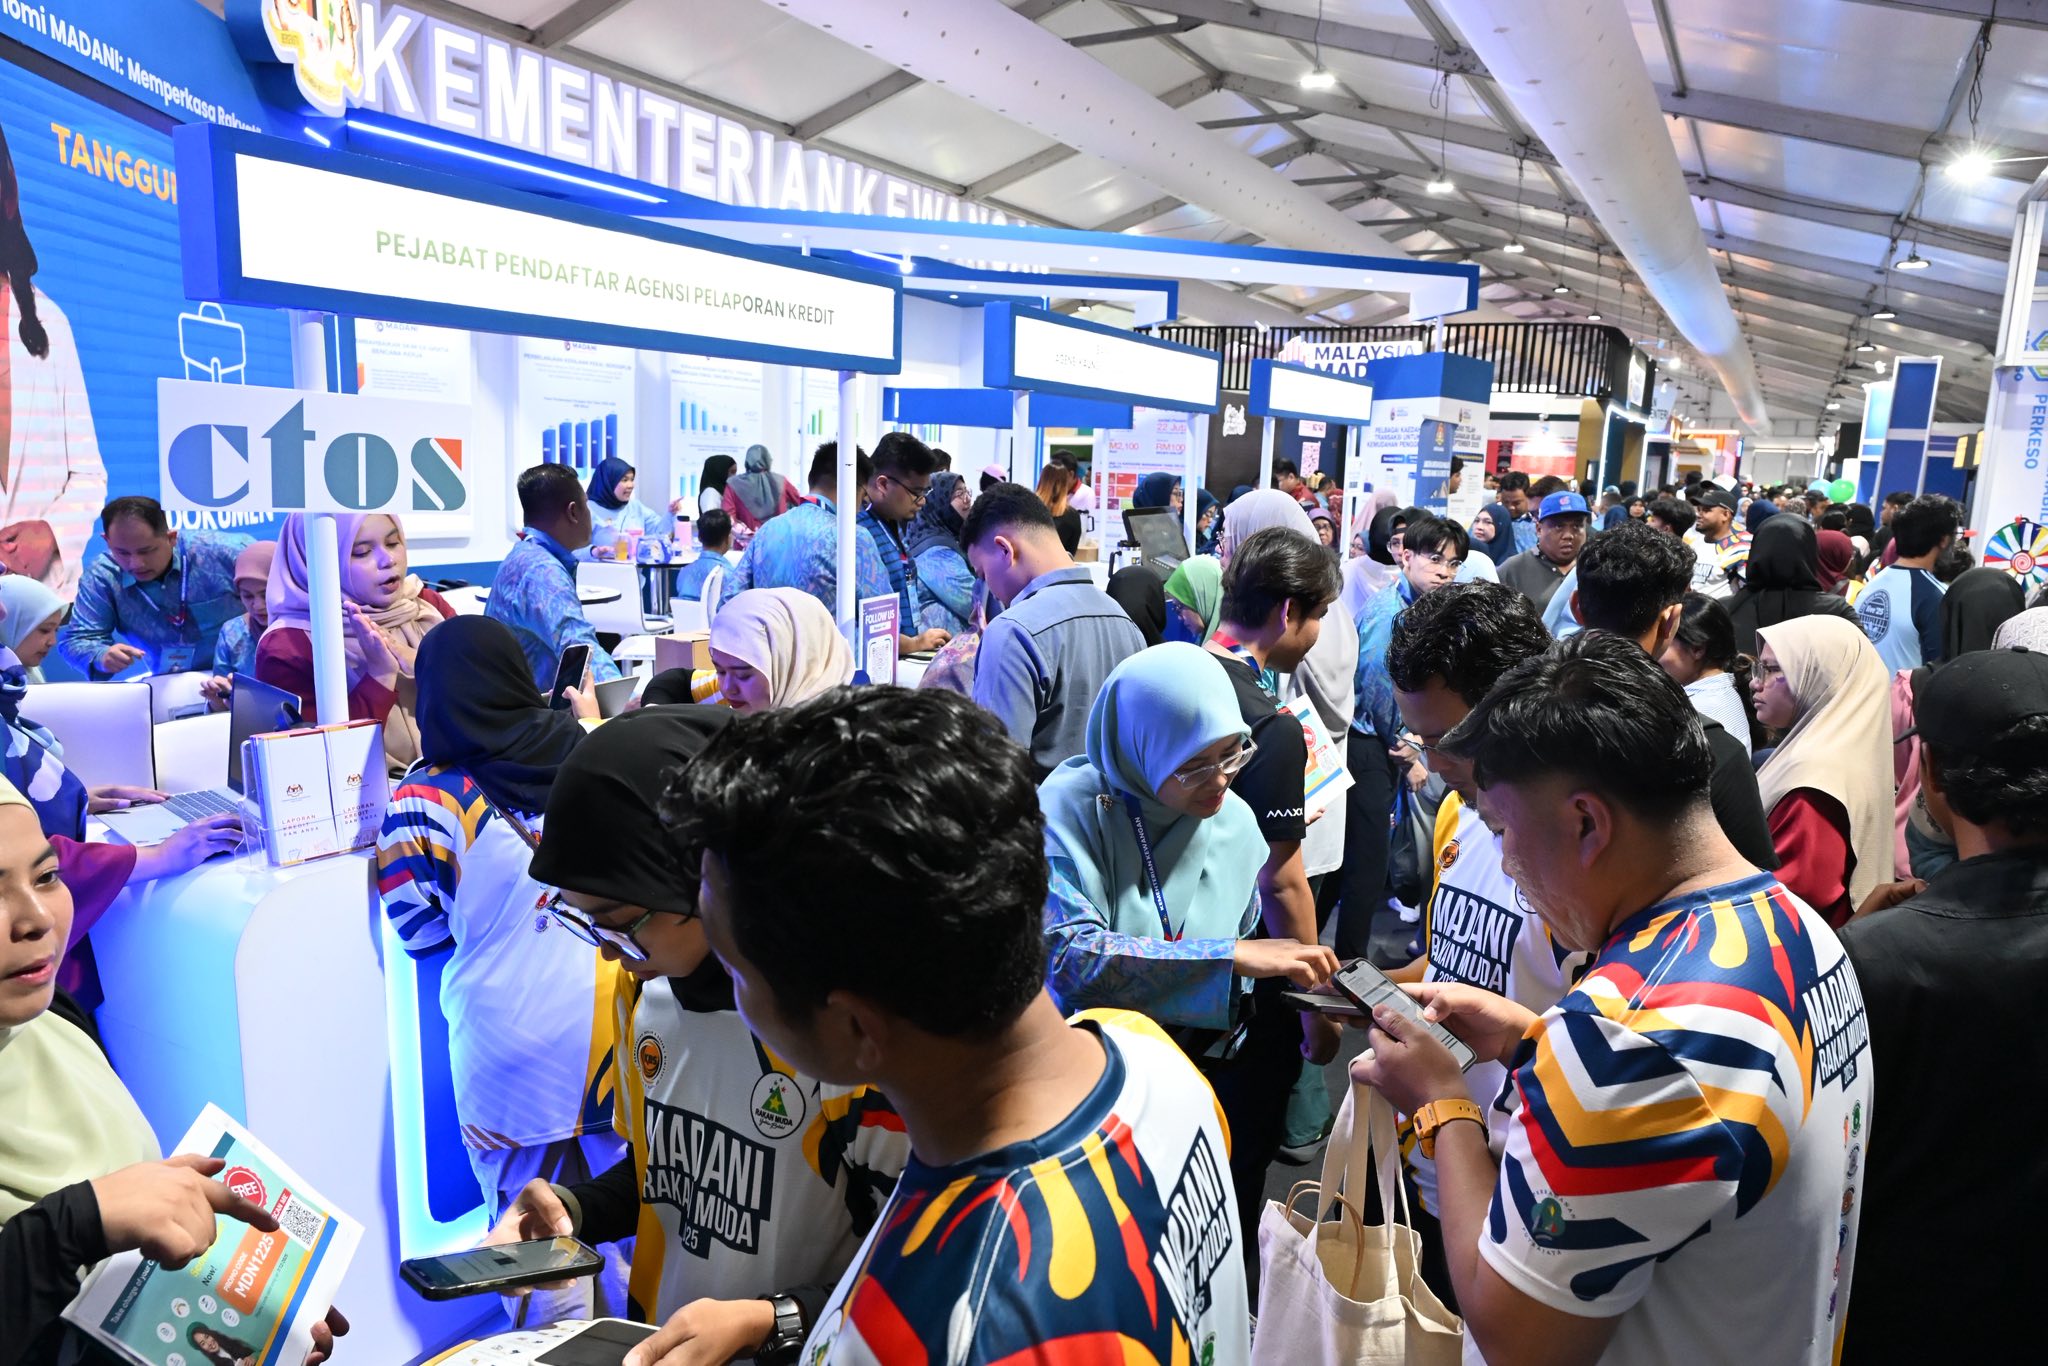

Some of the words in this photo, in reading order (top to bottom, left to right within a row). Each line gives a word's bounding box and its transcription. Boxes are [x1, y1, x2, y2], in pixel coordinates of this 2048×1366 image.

[49, 13, 124, 75] MADANI:
[127, 57, 216, 123] Memperkasa
[361, 2, 844, 214] KEMENTERIAN
[376, 230, 488, 270] PEJABAT
[495, 251, 620, 292] PENDAFTAR
[624, 275, 690, 303] AGENSI
[694, 287, 785, 318] PELAPORAN
[788, 302, 835, 325] KREDIT
[1314, 345, 1415, 360] MALAYSIA
[2024, 394, 2048, 470] PERKESO
[865, 611, 888, 625] FOLLOW
[887, 609, 895, 620] US
[281, 814, 316, 825] LAPORAN
[343, 802, 375, 814] LAPORAN
[1134, 816, 1151, 860] KEWANGAN
[1147, 860, 1165, 912] KEMENTERIAN
[1431, 886, 1514, 964] MADANI
[1457, 948, 1503, 993] MUDA
[1801, 957, 1864, 1048] MADANI
[1818, 1030, 1849, 1081] RAKAN
[755, 1107, 775, 1121] RAKAN
[774, 1115, 793, 1127] MUDA
[646, 1104, 765, 1210] MADANI
[230, 1181, 260, 1198] FREE
[271, 1202, 283, 1221] SCAN
[279, 1193, 288, 1205] ME
[693, 1190, 753, 1248] MUDA
[1153, 1136, 1223, 1326] MADANI
[223, 1267, 239, 1292] PROMO
[235, 1252, 249, 1270] CODE
[234, 1233, 276, 1298] MDN1225
[1198, 1206, 1231, 1288] MUDA
[110, 1308, 125, 1324] Take
[122, 1286, 139, 1309] charge
[135, 1277, 143, 1288] of
[140, 1267, 152, 1281] your
[201, 1265, 217, 1287] Now!
